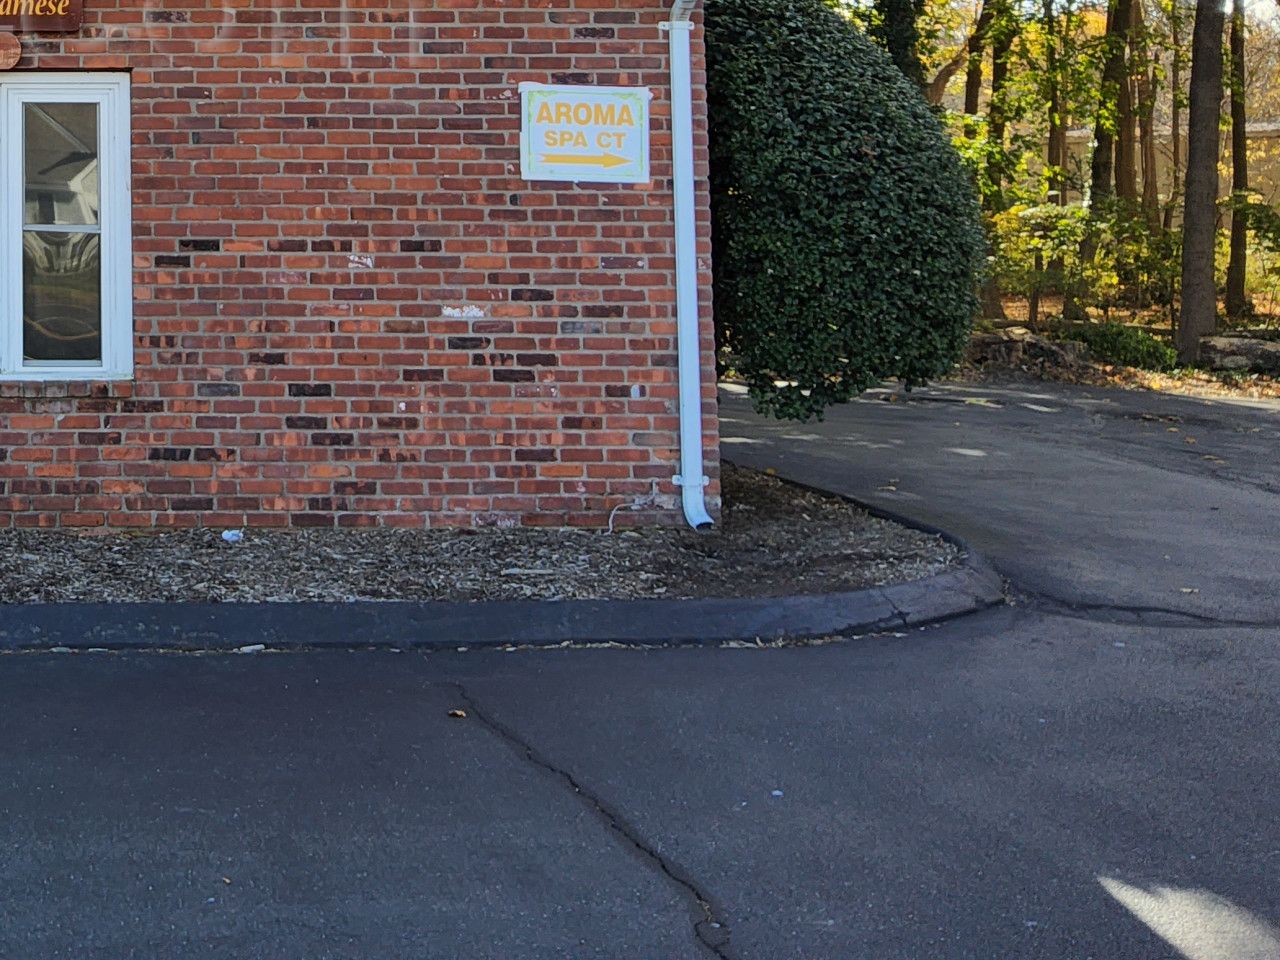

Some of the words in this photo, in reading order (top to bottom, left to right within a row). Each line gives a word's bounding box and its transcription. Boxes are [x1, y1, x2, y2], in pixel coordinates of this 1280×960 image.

[535, 101, 634, 126] AROMA
[544, 130, 588, 148] SPA
[596, 132, 627, 149] CT
